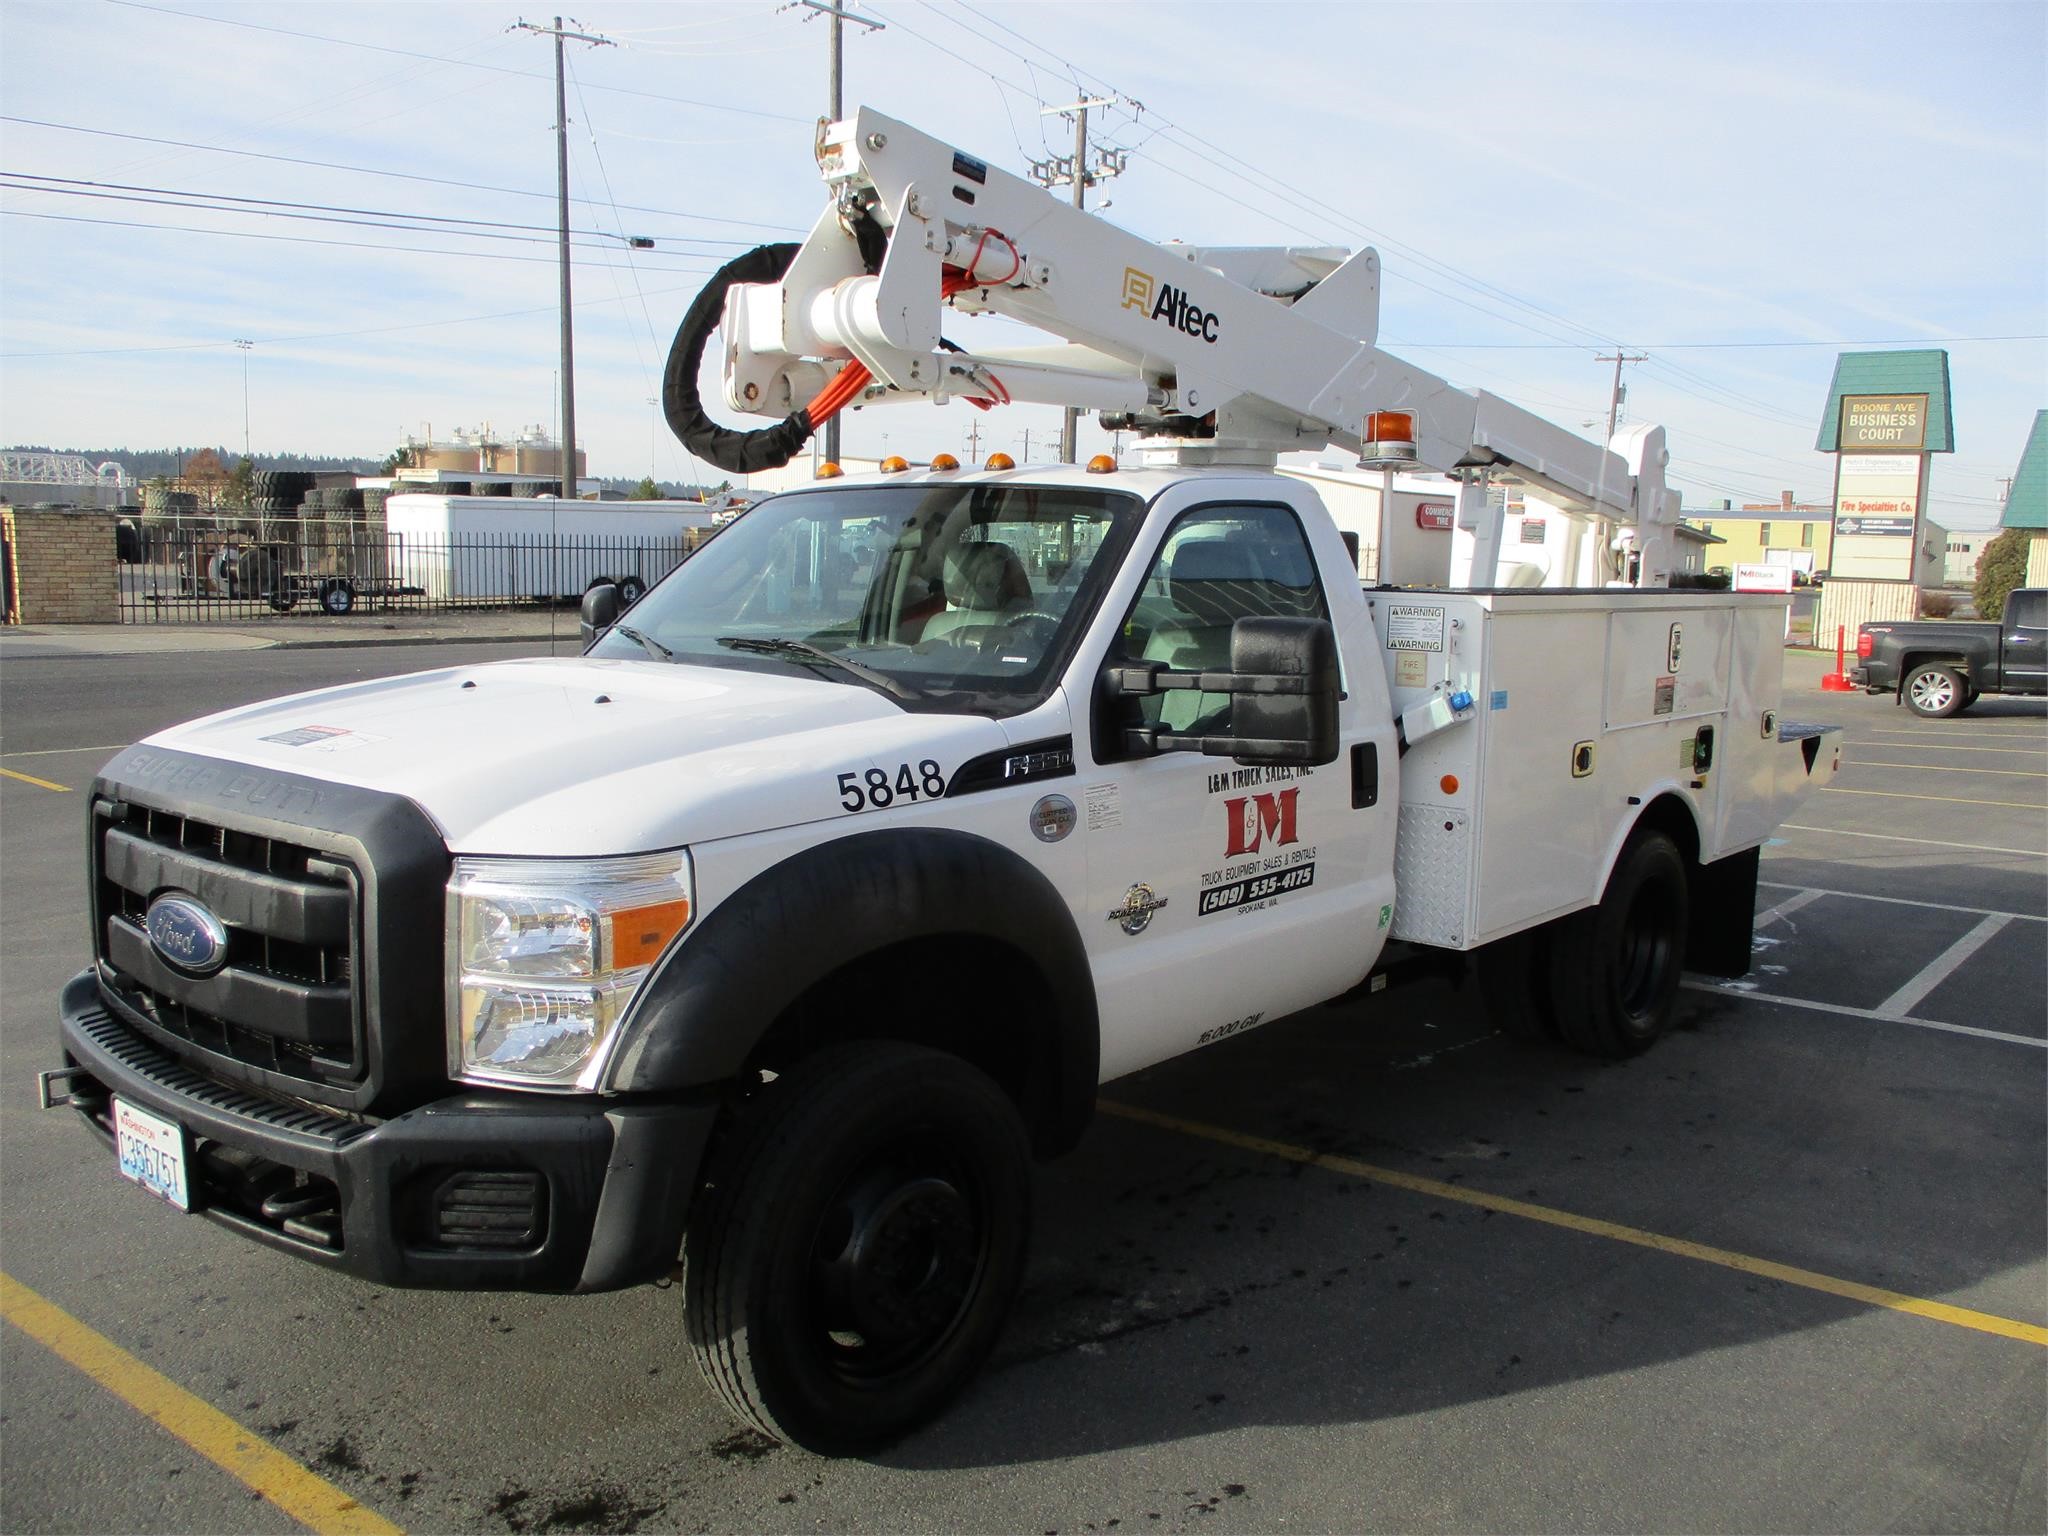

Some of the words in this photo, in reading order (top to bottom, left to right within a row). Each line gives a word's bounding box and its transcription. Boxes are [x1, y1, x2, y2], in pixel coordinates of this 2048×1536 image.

[1151, 283, 1219, 343] Altec
[1849, 414, 1916, 426] BUSINESS
[1852, 403, 1891, 413] BOONE
[1859, 428, 1904, 440] COURT
[1841, 501, 1855, 511] Fire
[1858, 501, 1898, 514] Specialties
[1901, 501, 1912, 512] Co.
[1437, 517, 1448, 526] TIRE
[1399, 608, 1441, 617] WARNING
[1398, 640, 1439, 650] WARNING
[125, 753, 222, 791] SUPER
[1208, 772, 1230, 793] L&M
[1232, 767, 1262, 789] TRUCK
[837, 759, 945, 812] 5848
[1201, 871, 1222, 886] TRUCK
[1226, 861, 1261, 880] EQUIPMENT
[1263, 855, 1282, 870] SALES
[1291, 847, 1317, 863] RENTALS
[1202, 884, 1245, 912] (509)
[1249, 867, 1311, 898] 535-4175
[157, 907, 195, 955] Ford
[120, 1131, 178, 1193] C35675T
